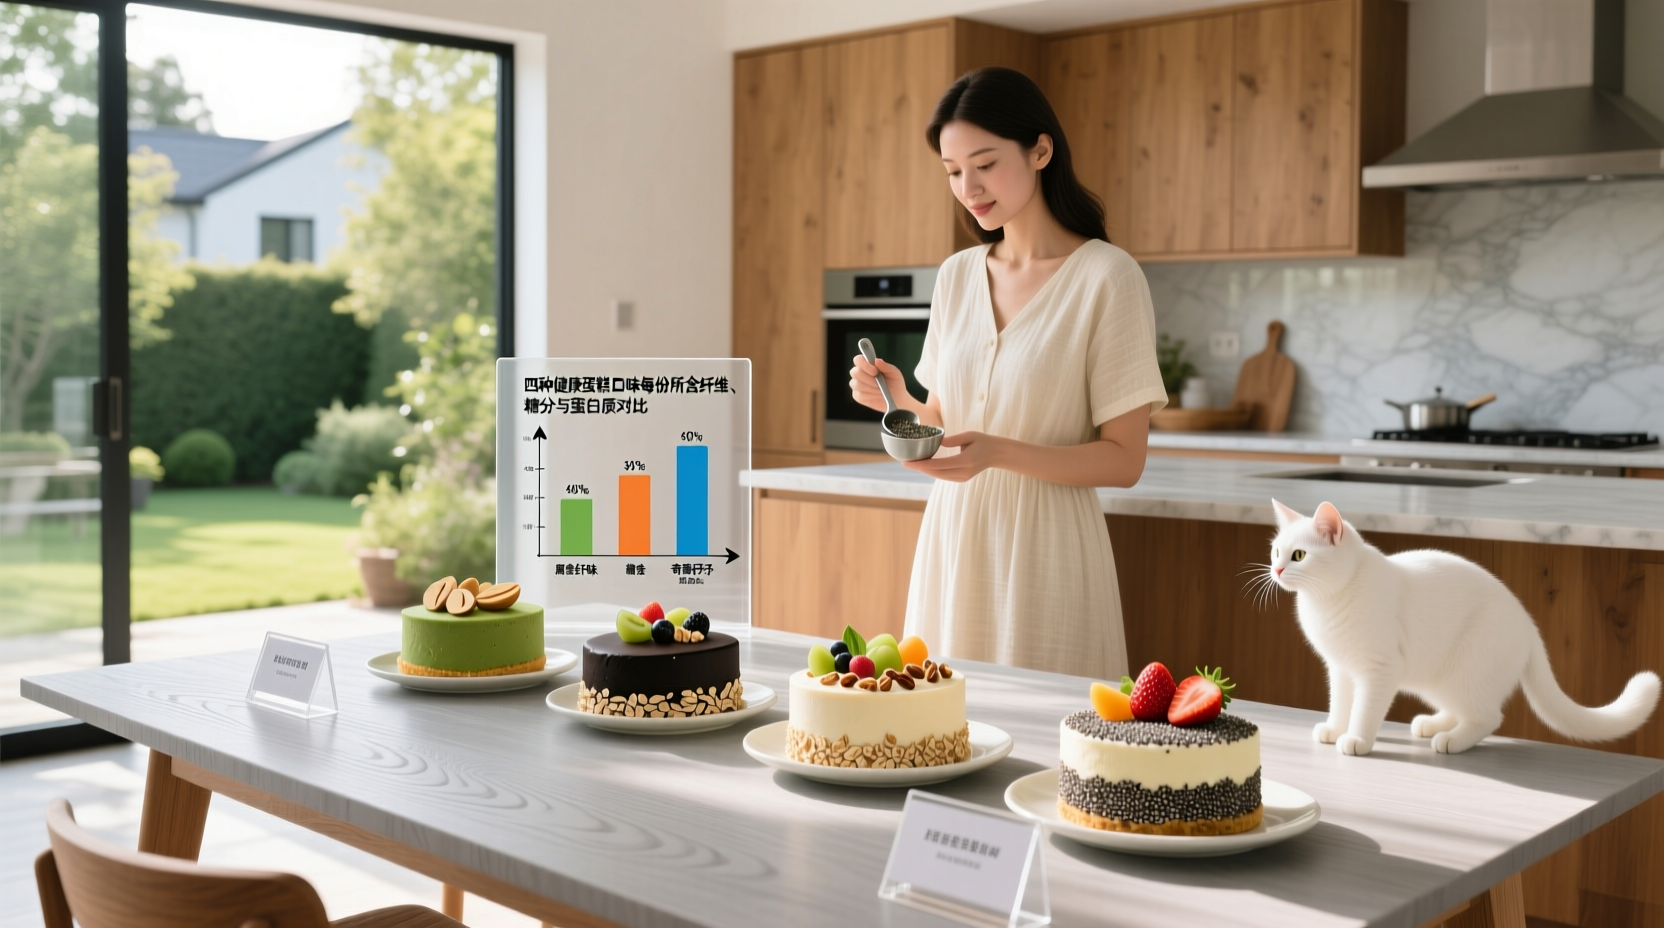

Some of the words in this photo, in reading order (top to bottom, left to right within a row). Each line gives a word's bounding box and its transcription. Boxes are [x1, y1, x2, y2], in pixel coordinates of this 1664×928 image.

[524, 397, 648, 414] 糖分与蛋白质对比
